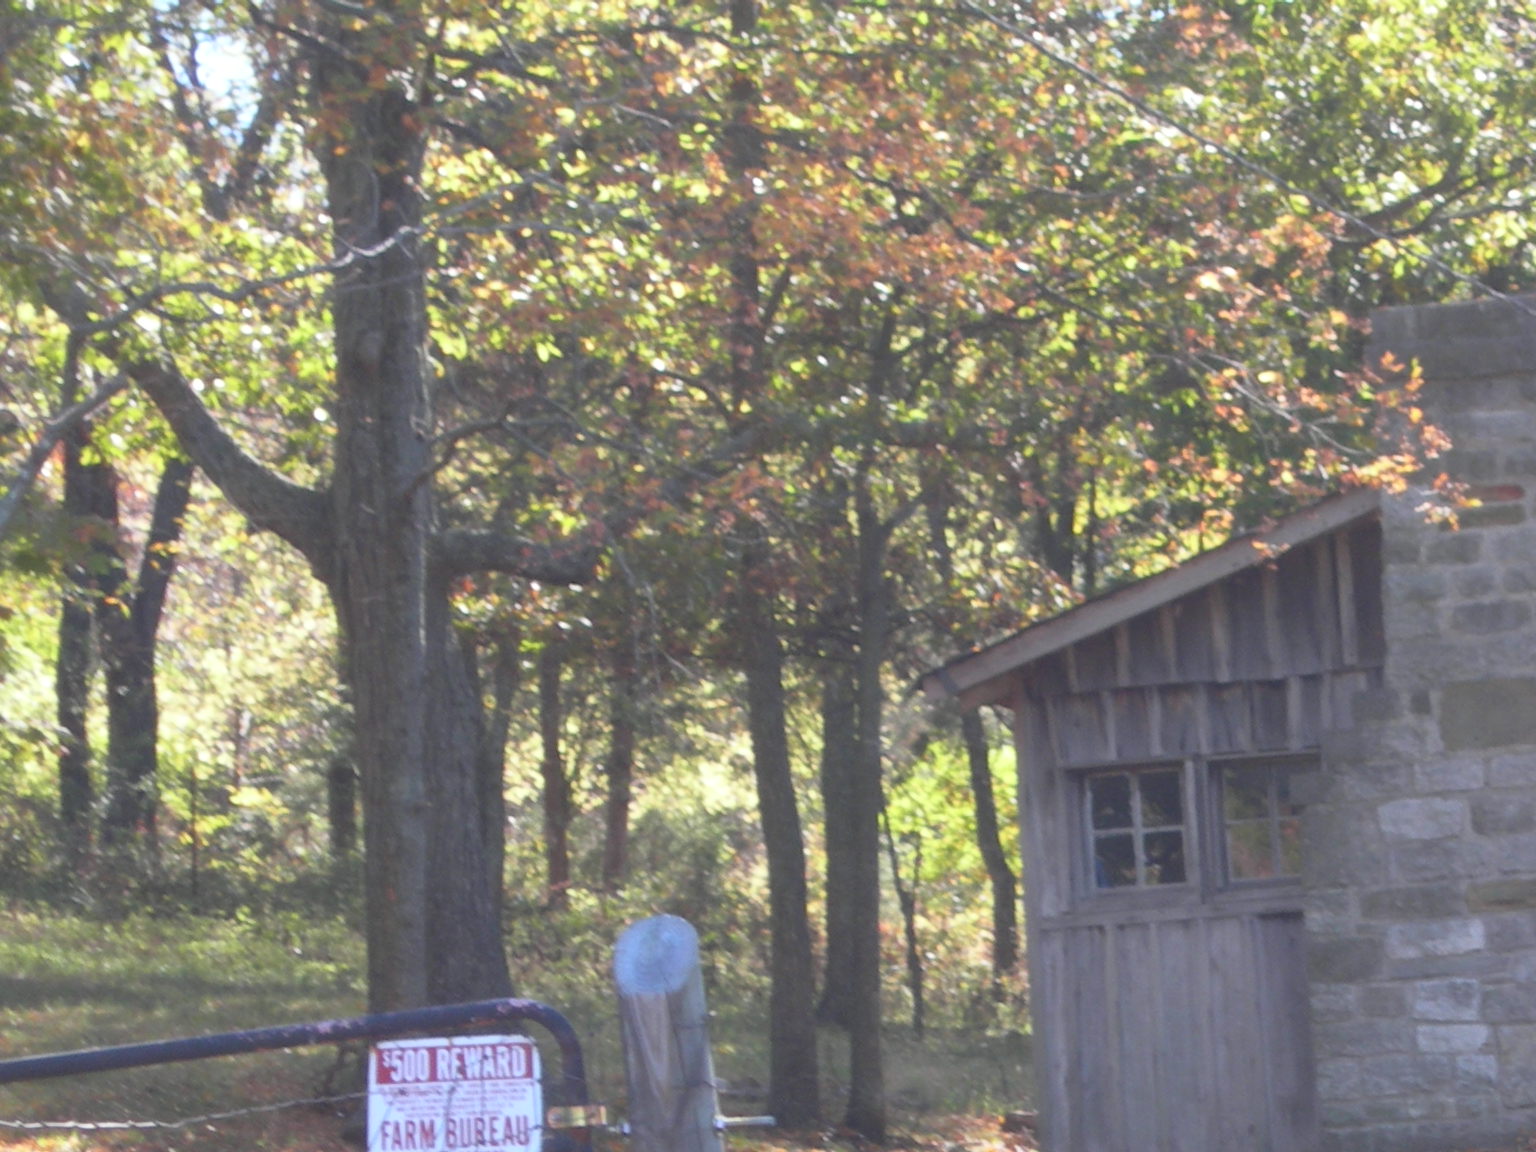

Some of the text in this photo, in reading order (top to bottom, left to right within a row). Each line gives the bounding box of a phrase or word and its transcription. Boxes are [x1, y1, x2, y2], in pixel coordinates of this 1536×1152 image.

[382, 1044, 527, 1083] $500 REWARD
[380, 1114, 530, 1151] FARM BUREAU
